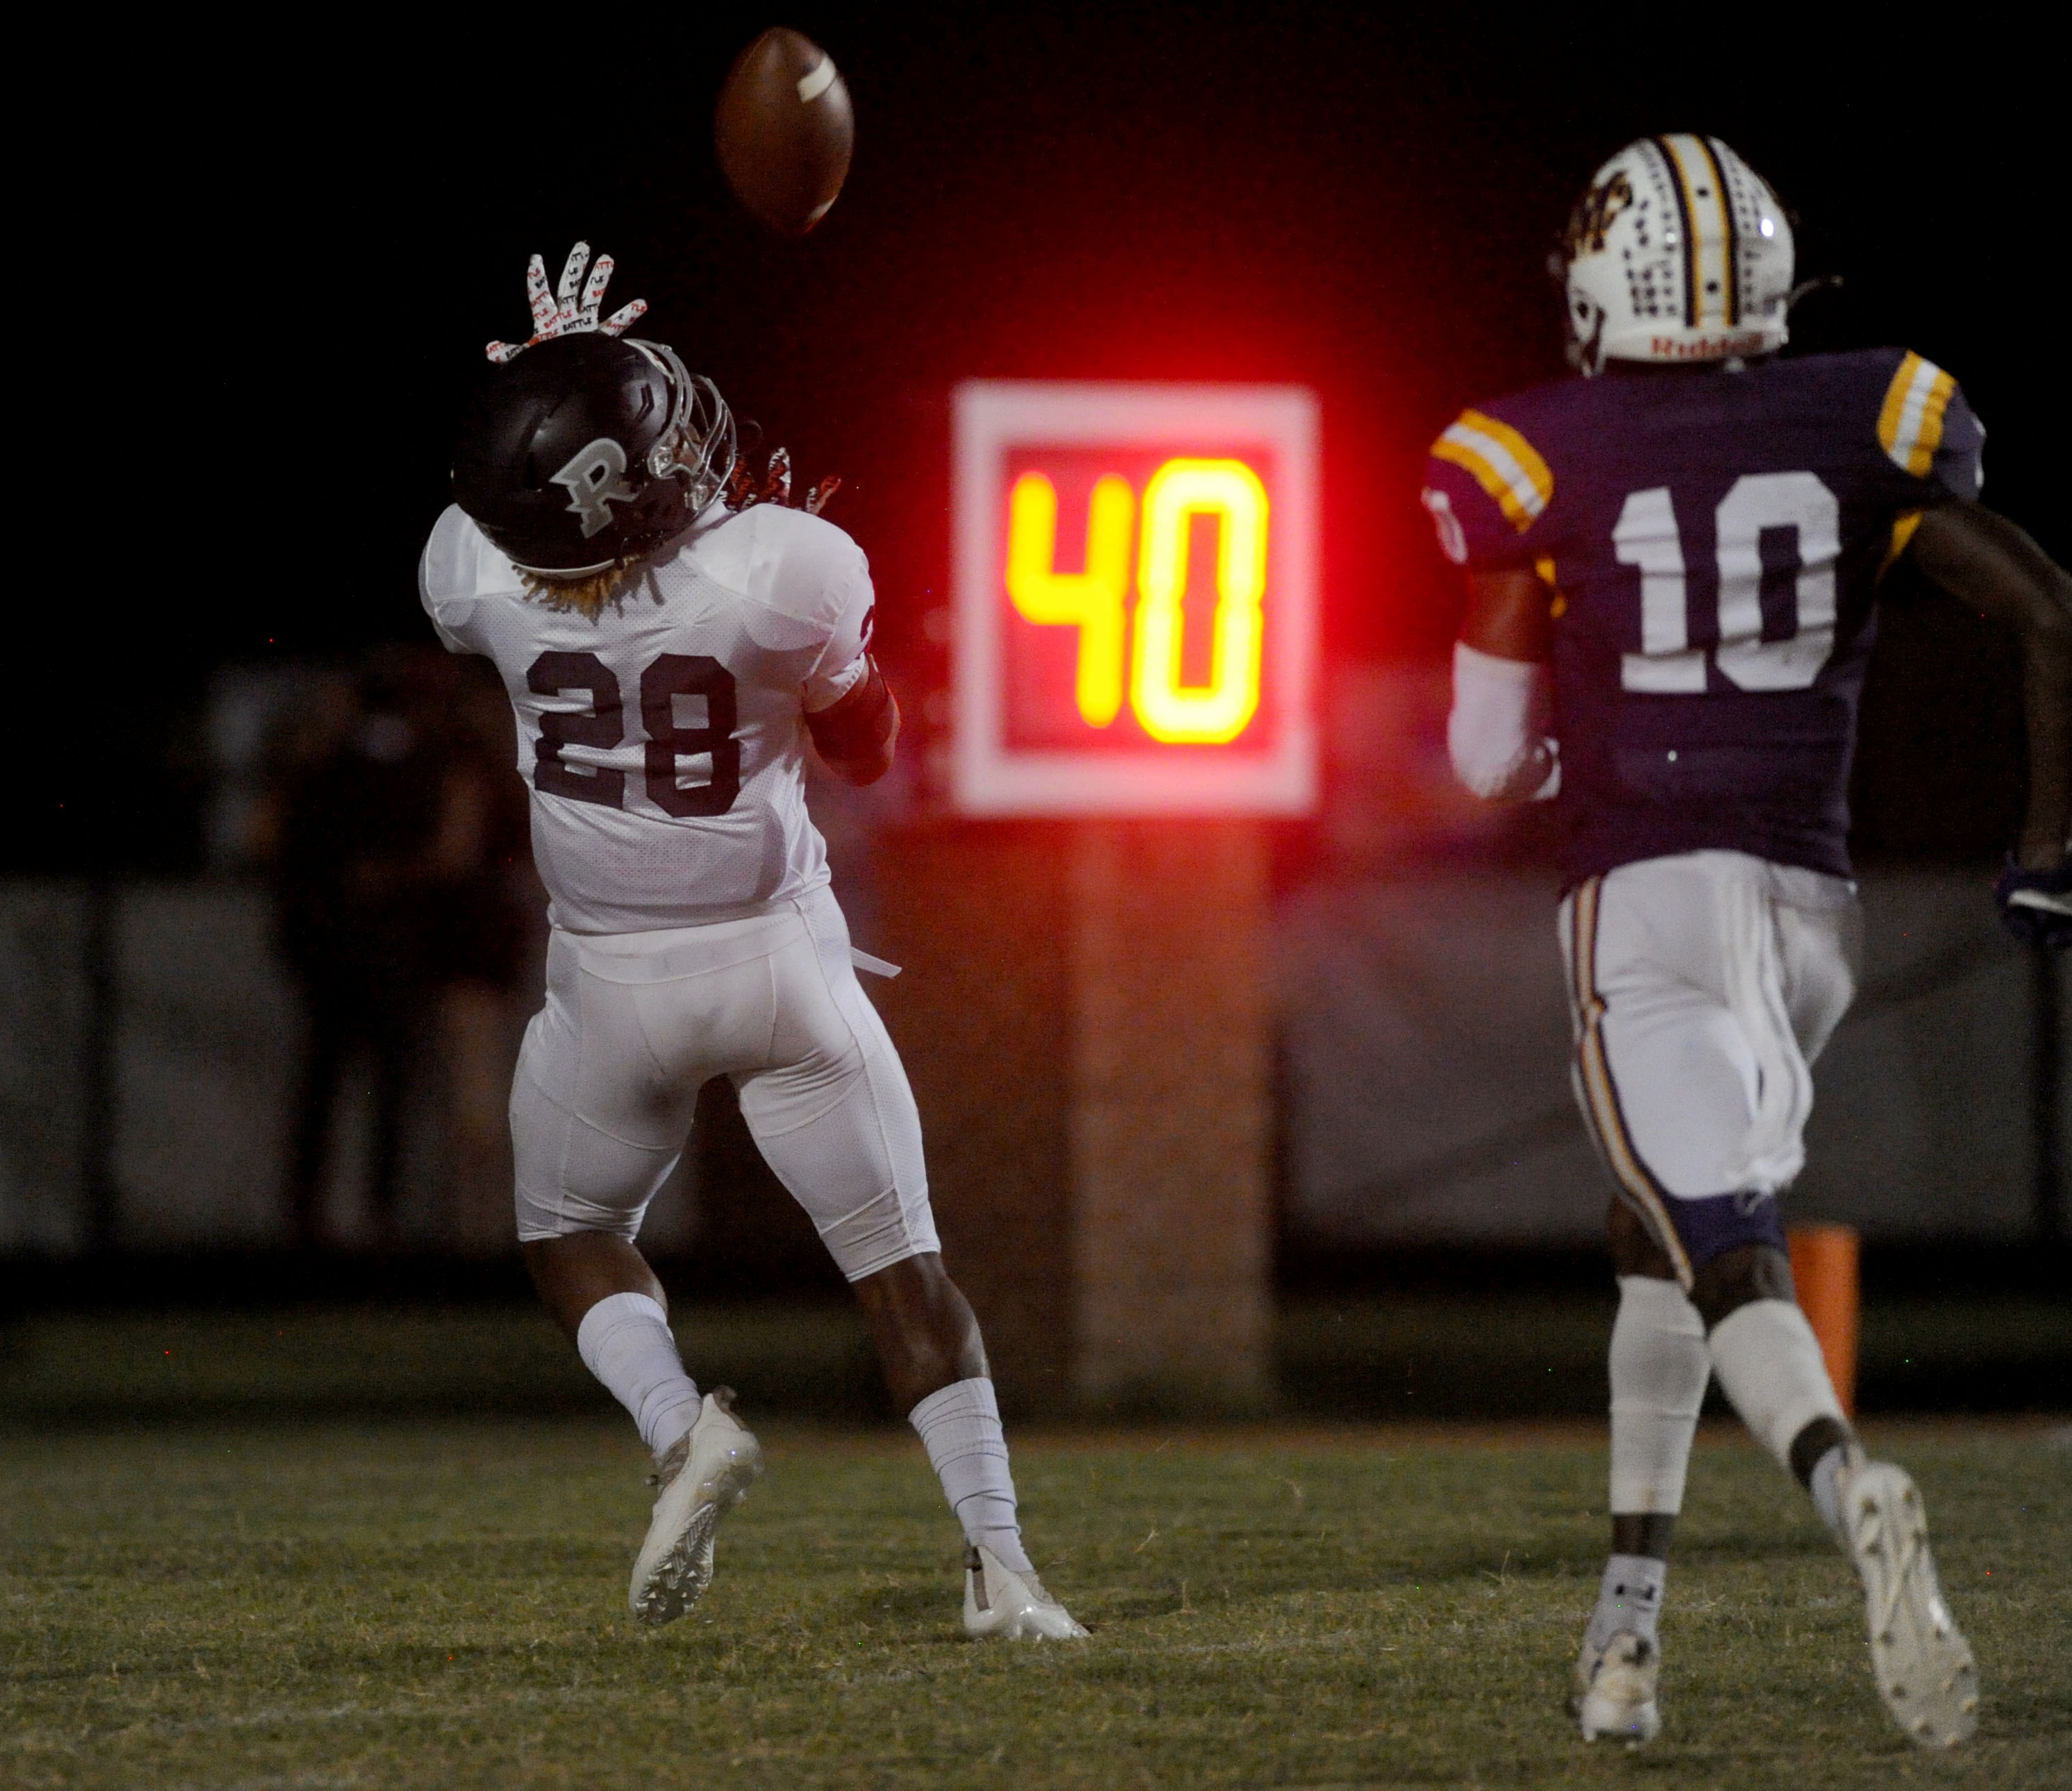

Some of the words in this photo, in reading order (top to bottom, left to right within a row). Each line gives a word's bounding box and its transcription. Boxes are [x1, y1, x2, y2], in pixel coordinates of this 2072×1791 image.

[562, 317, 592, 332] BATTLE
[549, 437, 639, 539] R
[1005, 457, 1270, 745] 40
[1611, 471, 1842, 693] 10
[525, 650, 741, 818] 28
